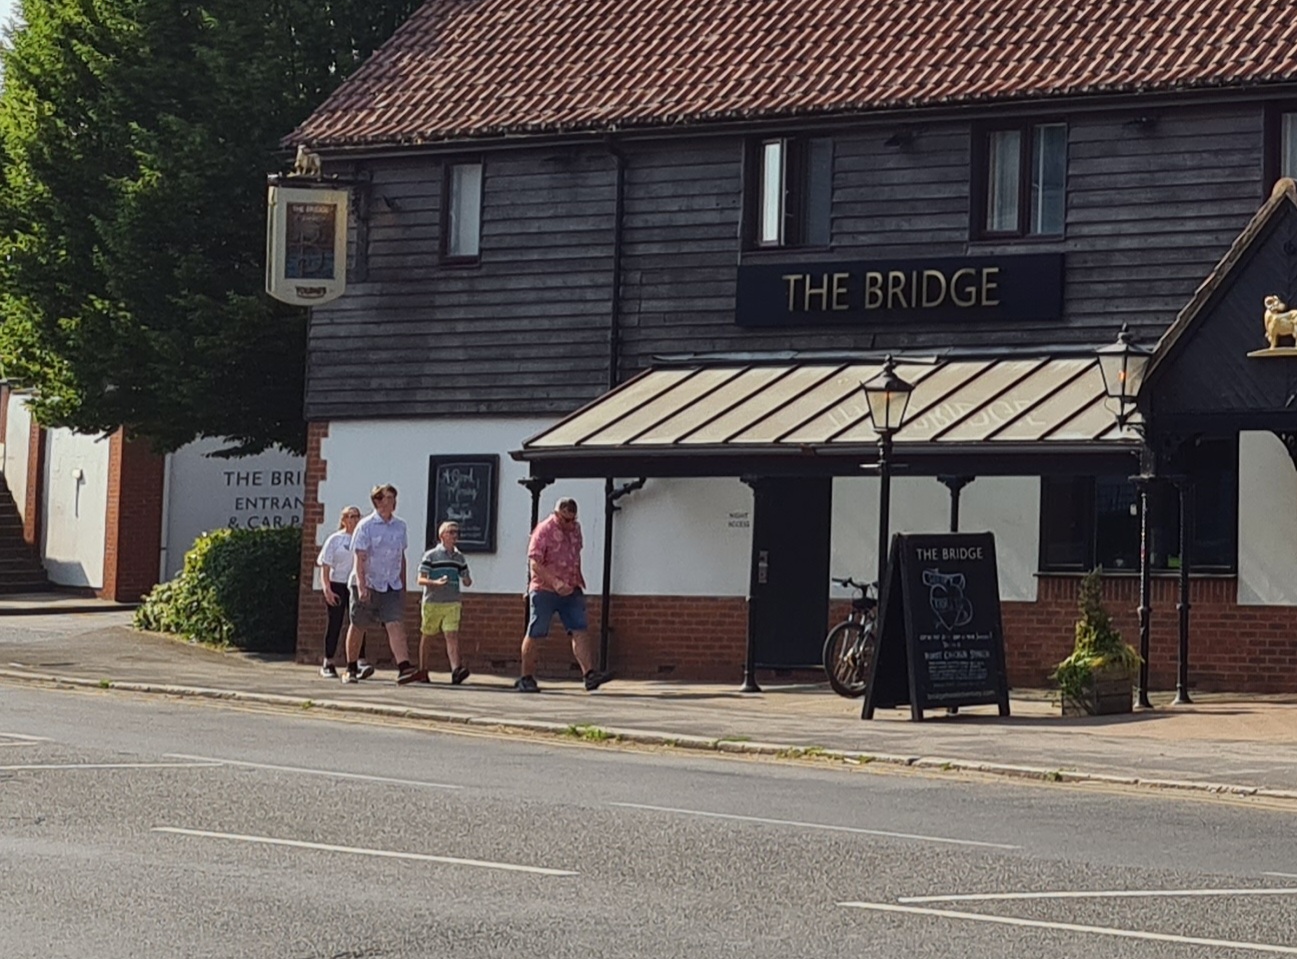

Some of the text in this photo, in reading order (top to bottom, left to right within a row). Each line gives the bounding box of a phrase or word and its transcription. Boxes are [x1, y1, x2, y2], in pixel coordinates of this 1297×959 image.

[292, 205, 305, 214] THE
[781, 267, 1000, 312] THE BRIDGE
[223, 470, 306, 487] THE BRI
[227, 515, 239, 530] &
[247, 515, 282, 530] CAR
[916, 547, 984, 561] THE BRIDGE
